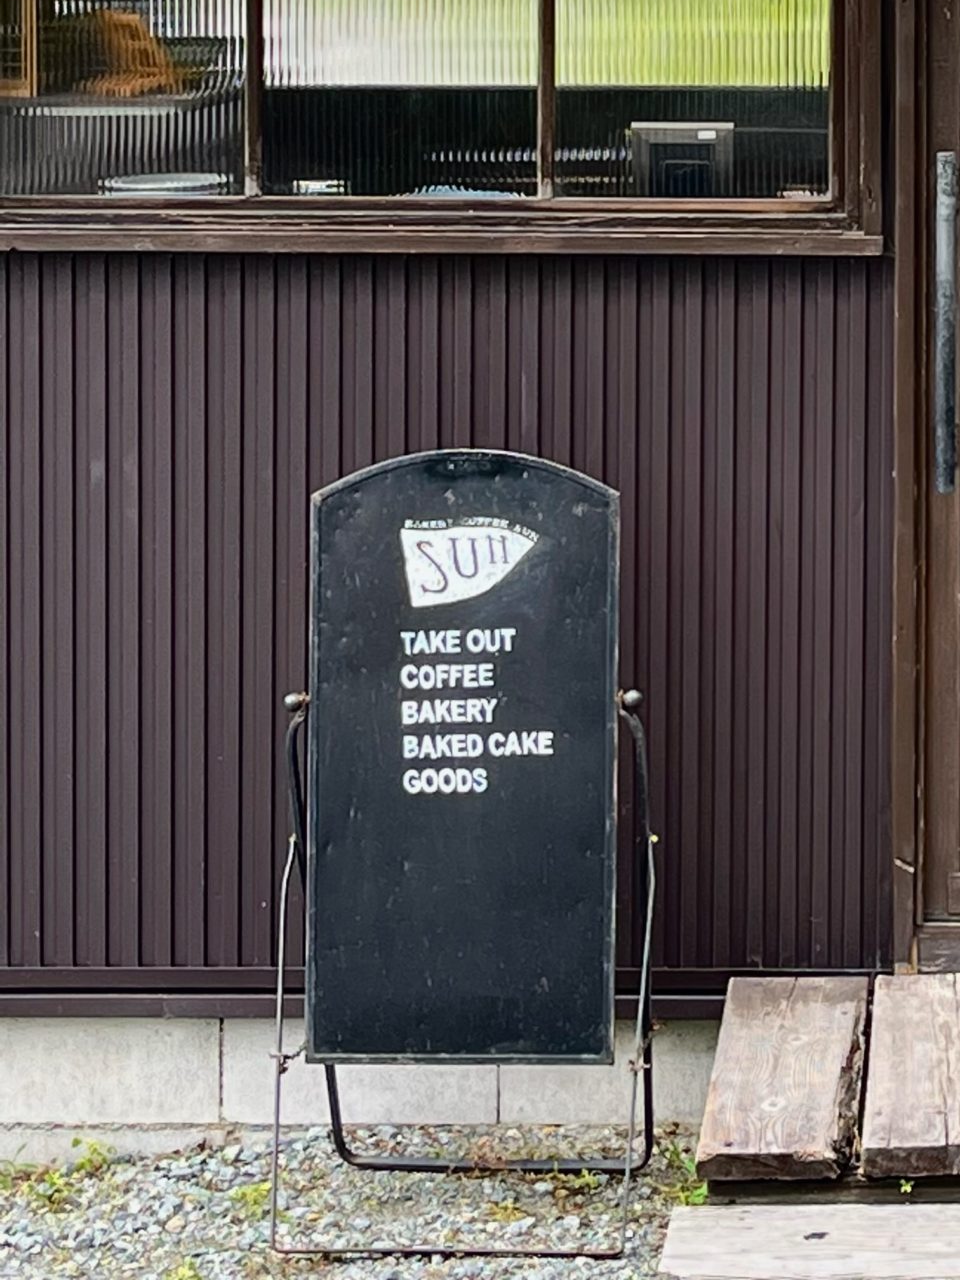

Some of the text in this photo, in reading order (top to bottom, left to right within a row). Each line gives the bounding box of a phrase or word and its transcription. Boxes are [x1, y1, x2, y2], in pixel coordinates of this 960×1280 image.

[400, 628, 516, 655] TAKE OUT
[400, 663, 494, 689] COFFEE
[402, 698, 498, 724] BAKERY
[403, 731, 554, 759] BAKED CAKE
[403, 768, 488, 794] GOODS
